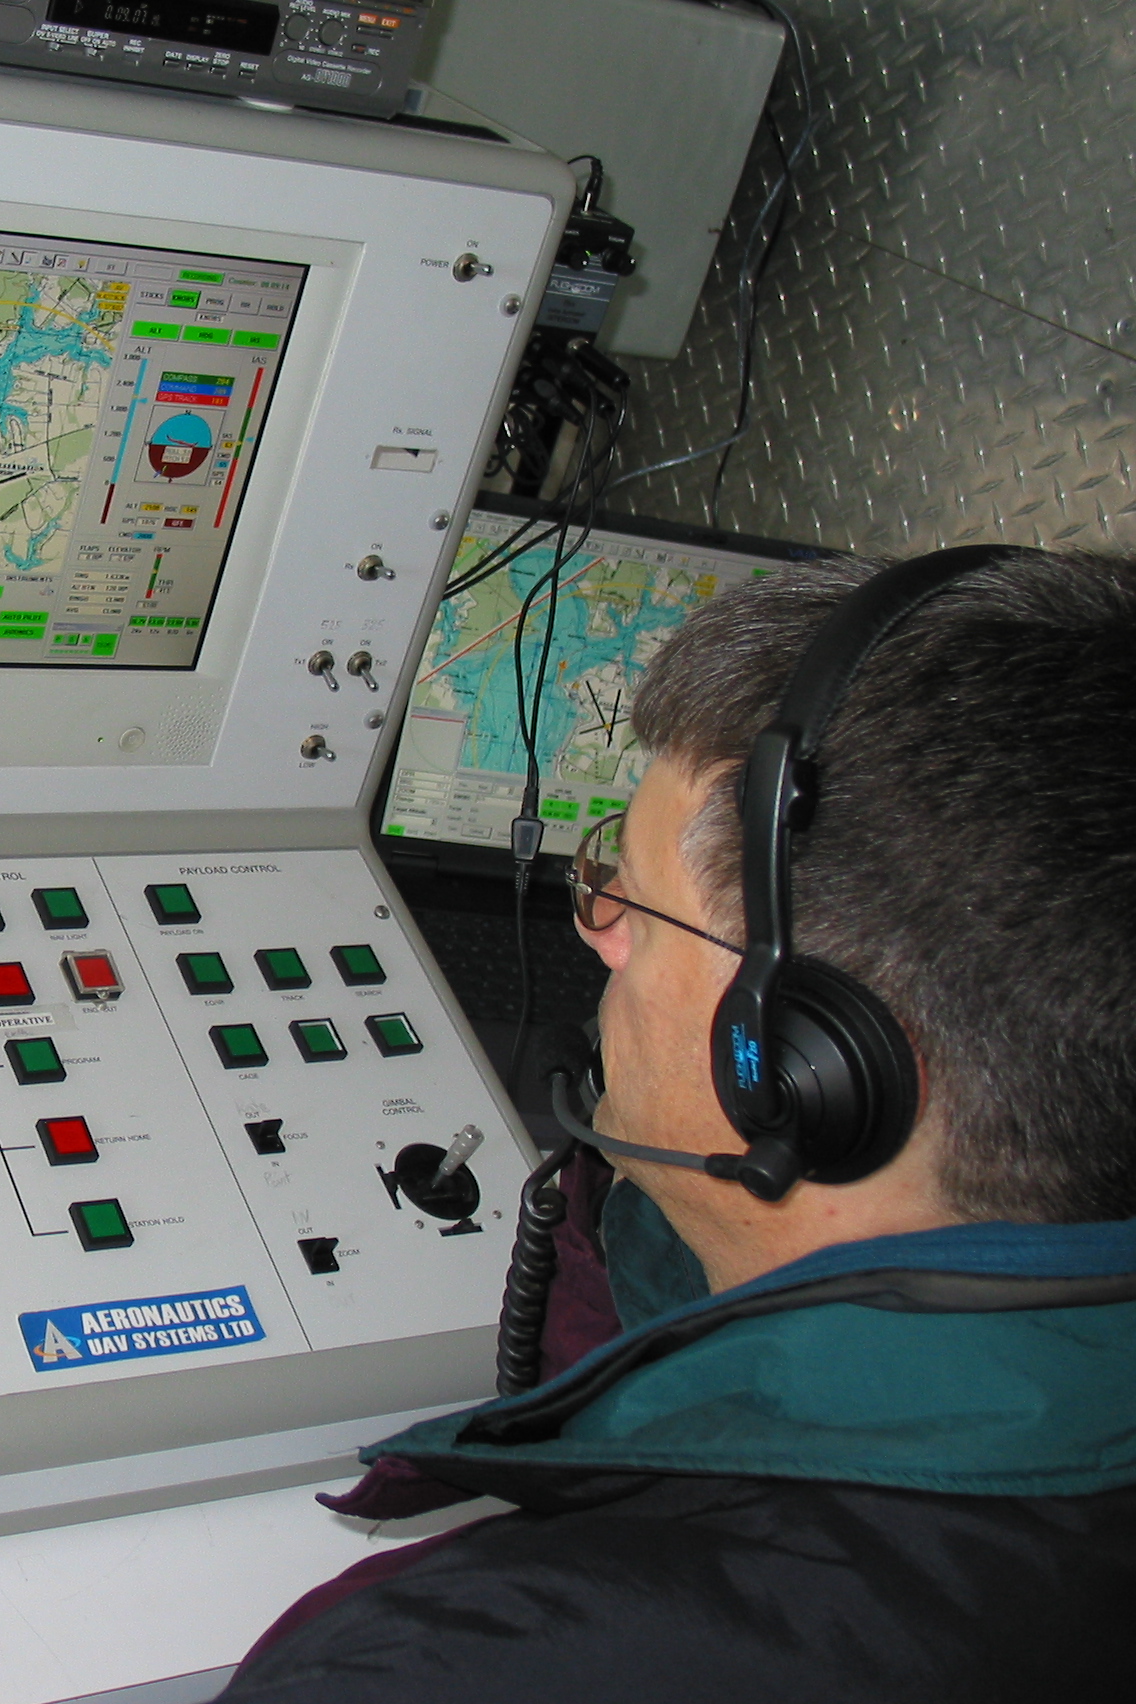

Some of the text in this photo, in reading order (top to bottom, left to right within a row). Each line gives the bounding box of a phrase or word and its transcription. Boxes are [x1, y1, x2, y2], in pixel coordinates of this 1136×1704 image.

[358, 14, 397, 27] MENU EXIT
[240, 62, 260, 70] RESET
[420, 258, 449, 269] POWER
[163, 373, 197, 383] COMPASS
[406, 427, 433, 437] SIGNAL
[179, 864, 282, 875] PAYLOAD CONTROL
[66, 933, 88, 941] LIGHT
[63, 1057, 101, 1065] PROGRAM
[382, 1098, 416, 1107] GIMBAL
[382, 1106, 425, 1116] CONTROL
[95, 1133, 151, 1145] RETURN HOME
[283, 1132, 308, 1141] FOCUS
[163, 1216, 185, 1226] HOLD
[338, 1249, 361, 1258] ZOOM
[81, 1294, 247, 1335] AERONAUTICS
[87, 1319, 256, 1357] UAV SYSTEMS LTD
